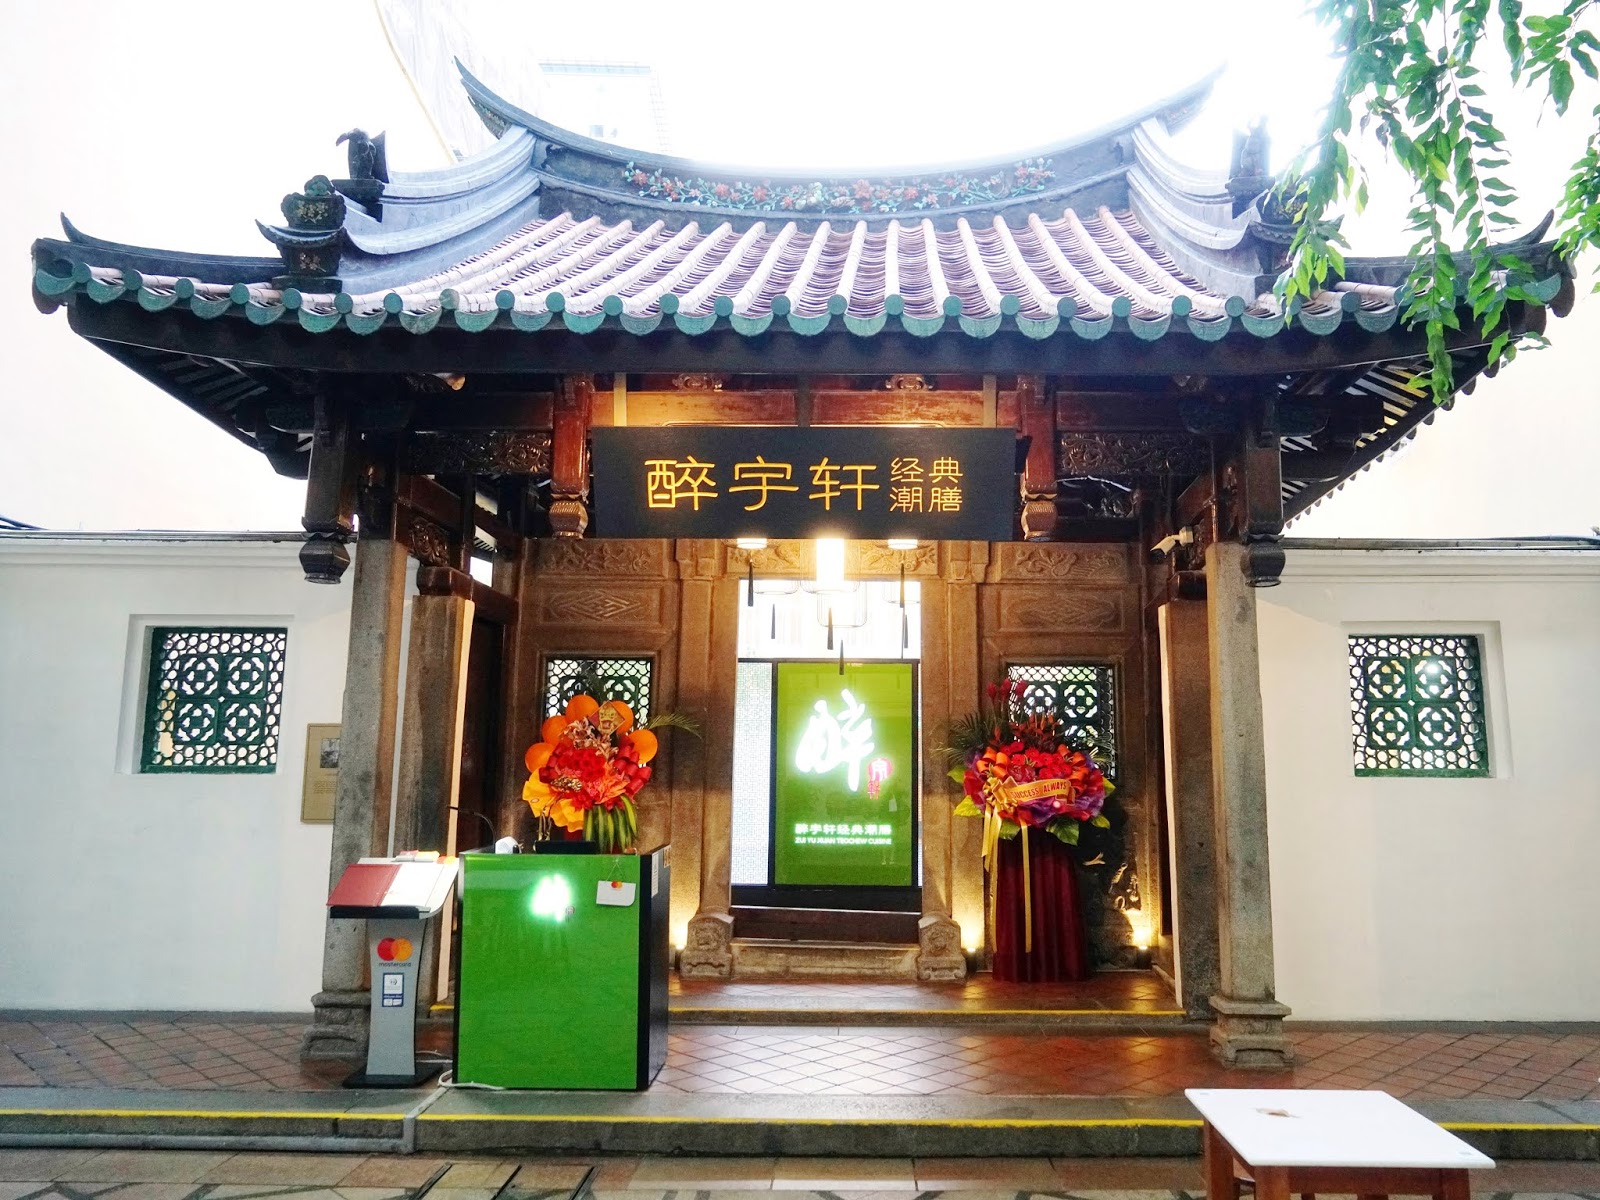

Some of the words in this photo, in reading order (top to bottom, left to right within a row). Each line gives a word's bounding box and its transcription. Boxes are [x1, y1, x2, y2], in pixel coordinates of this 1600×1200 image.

[644, 454, 880, 512] 醉宇轩
[890, 456, 964, 484] 经典
[889, 485, 964, 513] 潮膳
[1010, 788, 1040, 799] SUCCESS
[1043, 781, 1067, 793] ALWAYS
